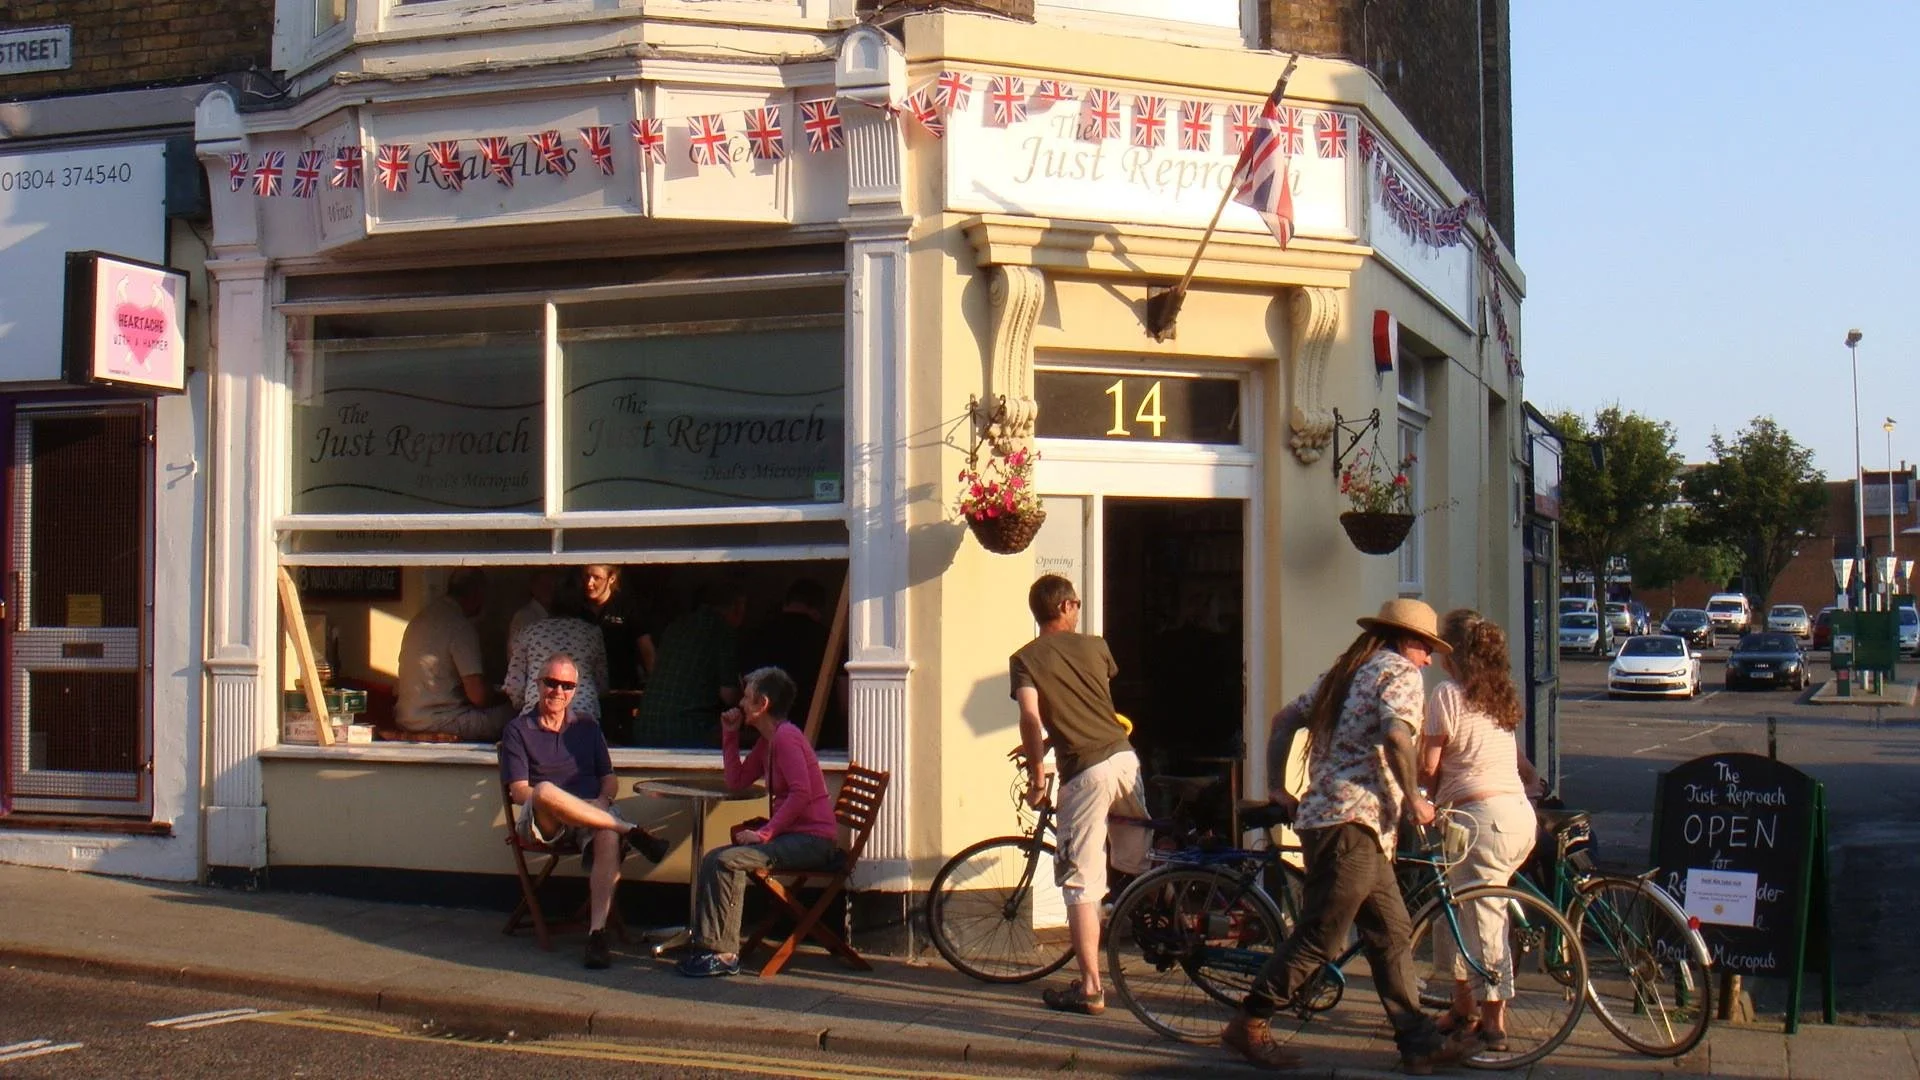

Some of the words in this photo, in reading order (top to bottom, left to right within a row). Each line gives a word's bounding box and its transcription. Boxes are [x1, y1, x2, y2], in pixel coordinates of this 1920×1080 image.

[1051, 113, 1094, 141] The
[2, 169, 55, 191] 01304
[62, 163, 131, 188] 374540
[415, 149, 492, 190] Ral
[1013, 136, 1105, 184] Just
[1122, 146, 1302, 201] Repro
[118, 314, 164, 333] HEARTACHE
[339, 403, 368, 424] The
[612, 392, 648, 415] The
[1105, 379, 1166, 437] 14
[310, 427, 375, 464] Just
[387, 417, 530, 468] Reproach
[668, 404, 825, 458] Reproach
[463, 468, 529, 493] Micropub
[1035, 556, 1075, 569] Opening
[1714, 762, 1740, 783] The
[1684, 784, 1718, 805] Just
[1725, 785, 1787, 808] Reproach
[1684, 814, 1777, 848] OPEN
[1711, 850, 1733, 869] for
[1667, 872, 1687, 898] Re
[1756, 882, 1784, 902] der
[1712, 944, 1776, 974] Micropub
